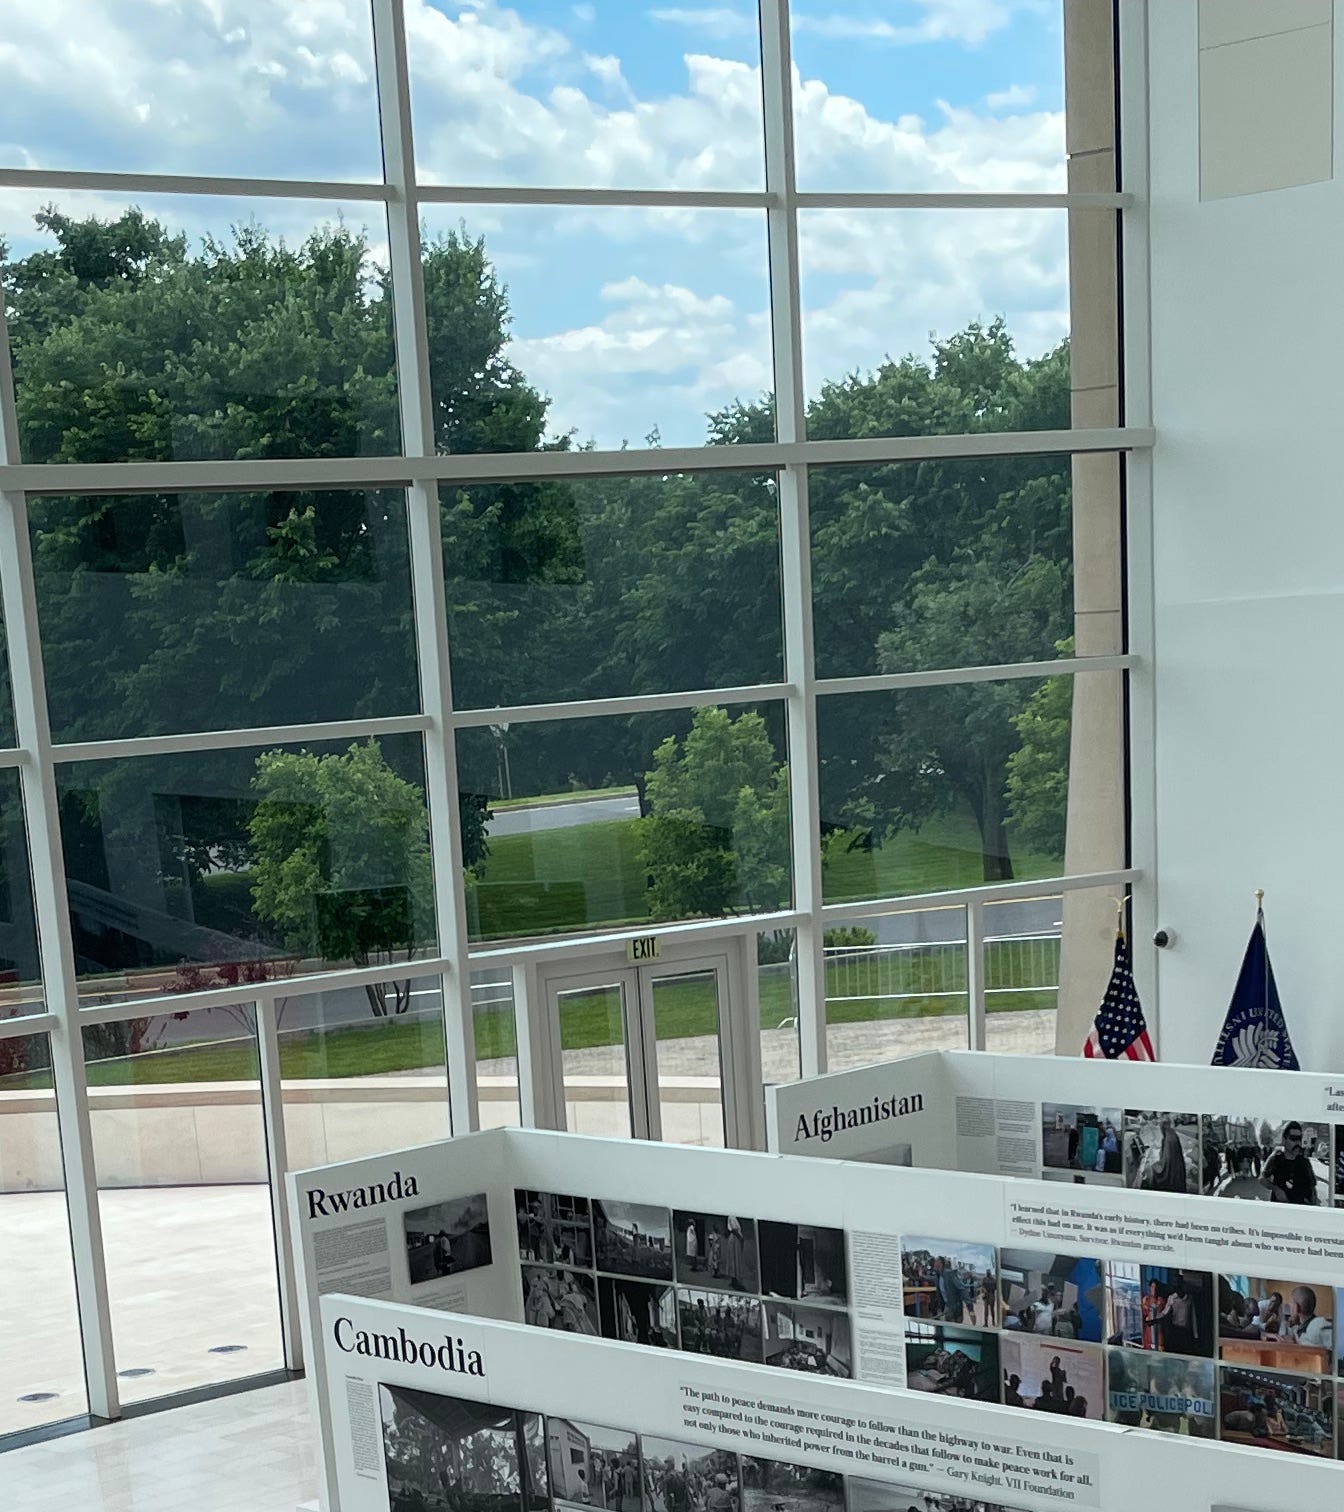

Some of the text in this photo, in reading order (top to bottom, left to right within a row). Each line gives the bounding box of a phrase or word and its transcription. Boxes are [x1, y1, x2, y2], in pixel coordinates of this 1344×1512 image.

[632, 936, 656, 959] EXIT
[794, 1093, 924, 1142] Afghanistan
[306, 1171, 420, 1220] Rwanda
[333, 1317, 485, 1377] Cambodia
[682, 1403, 1093, 1487] easy compared to the courage required in the decades that follow to make peace work for all.
[701, 1391, 720, 1403] path
[721, 1394, 730, 1404] to
[731, 1397, 756, 1409] peace
[756, 1399, 795, 1416] demands
[796, 1408, 819, 1420] more
[820, 1413, 856, 1428] courage
[856, 1418, 867, 1428] to
[867, 1419, 896, 1433] follow
[897, 1424, 920, 1438] than
[920, 1429, 937, 1442] the
[938, 1431, 979, 1451] highway
[980, 1440, 991, 1451] to
[991, 1443, 1013, 1455] war.
[1015, 1445, 1041, 1460] Even
[1041, 1450, 1063, 1464] that
[1064, 1453, 1074, 1466] is
[683, 1418, 697, 1428] not
[697, 1421, 717, 1434] only
[717, 1423, 741, 1437] those
[741, 1428, 761, 1440] who
[761, 1431, 802, 1448] inherited
[803, 1441, 831, 1453] power
[831, 1444, 854, 1458] from
[854, 1448, 870, 1461] the
[870, 1451, 900, 1467] barrel
[900, 1459, 907, 1468] a
[945, 1465, 969, 1481] Gary
[1004, 1475, 1021, 1490] VII
[1022, 1479, 1075, 1500] Foundation
